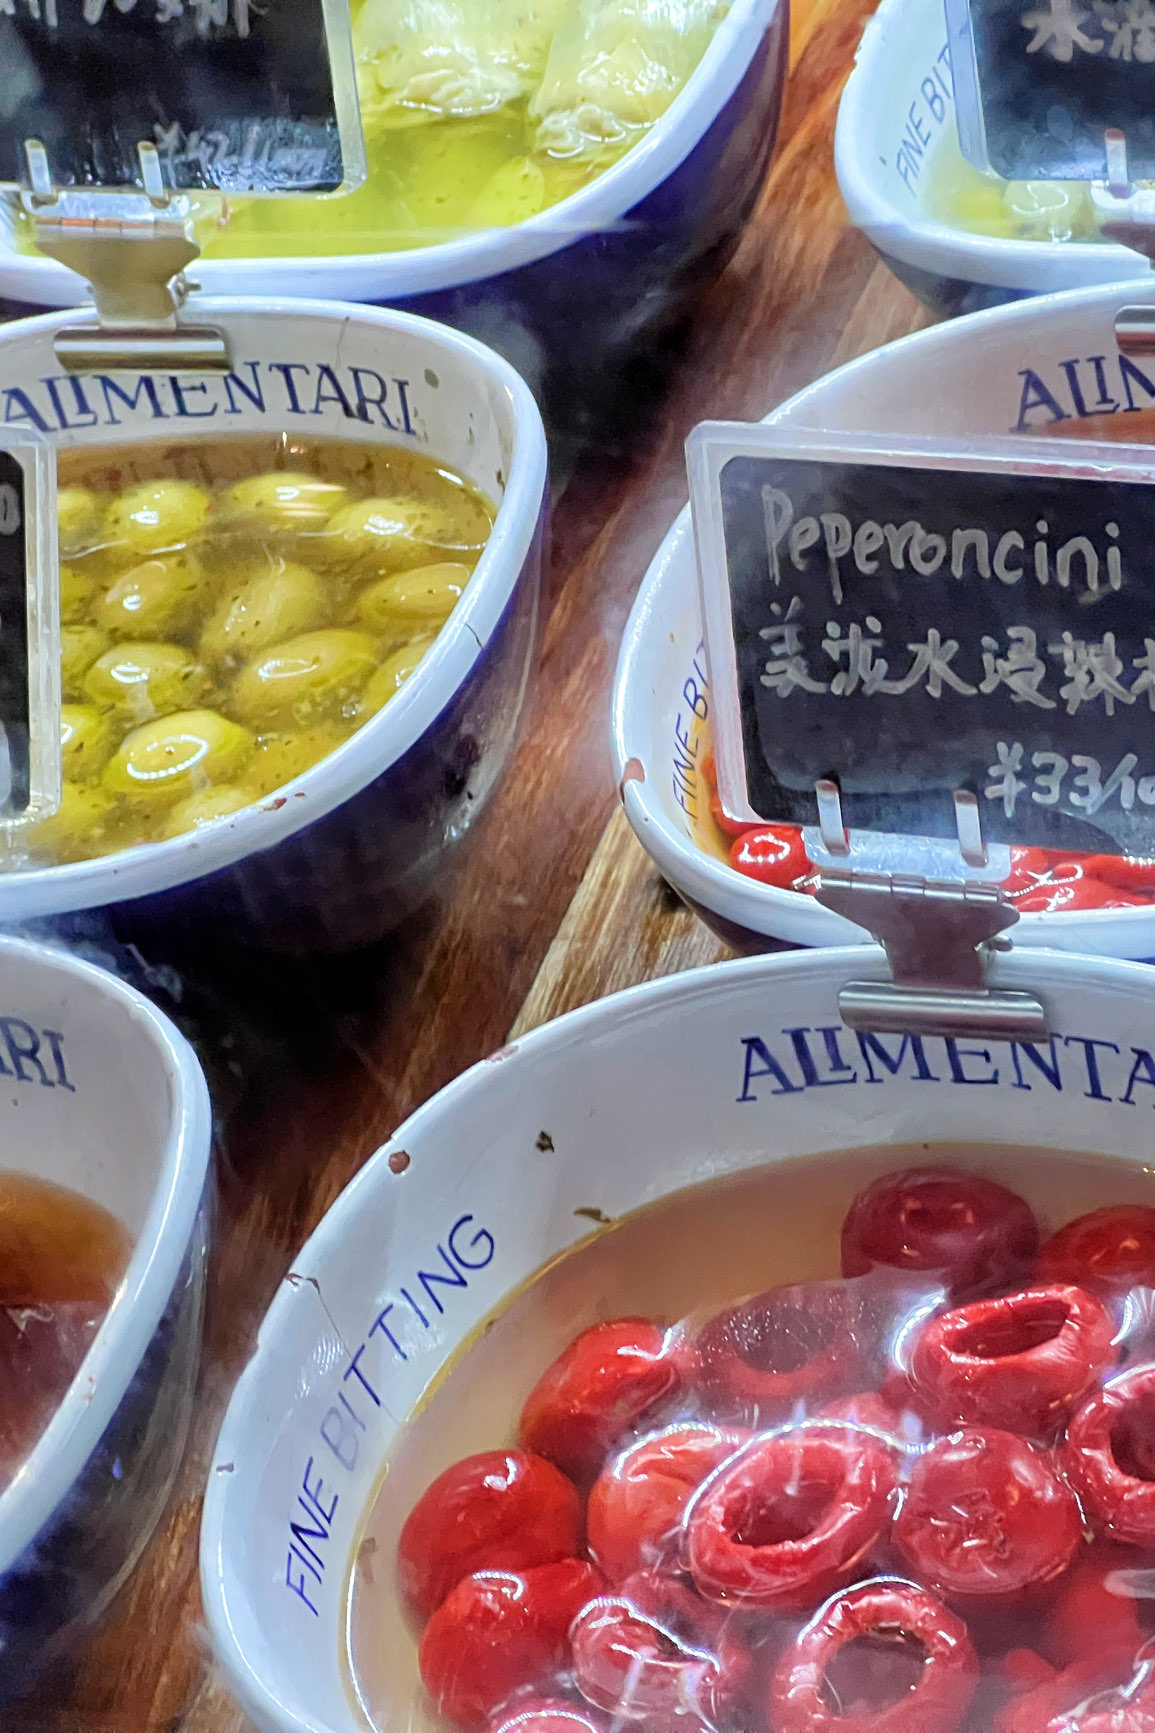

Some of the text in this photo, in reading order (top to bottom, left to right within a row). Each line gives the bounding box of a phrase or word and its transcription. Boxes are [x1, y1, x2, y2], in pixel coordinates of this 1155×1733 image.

[896, 101, 931, 198] FINE
[2, 361, 417, 436] ALIMENTARI
[761, 484, 1122, 605] Peperoncini
[672, 638, 709, 820] FINE BI
[286, 1215, 494, 1616] FINE BITTING
